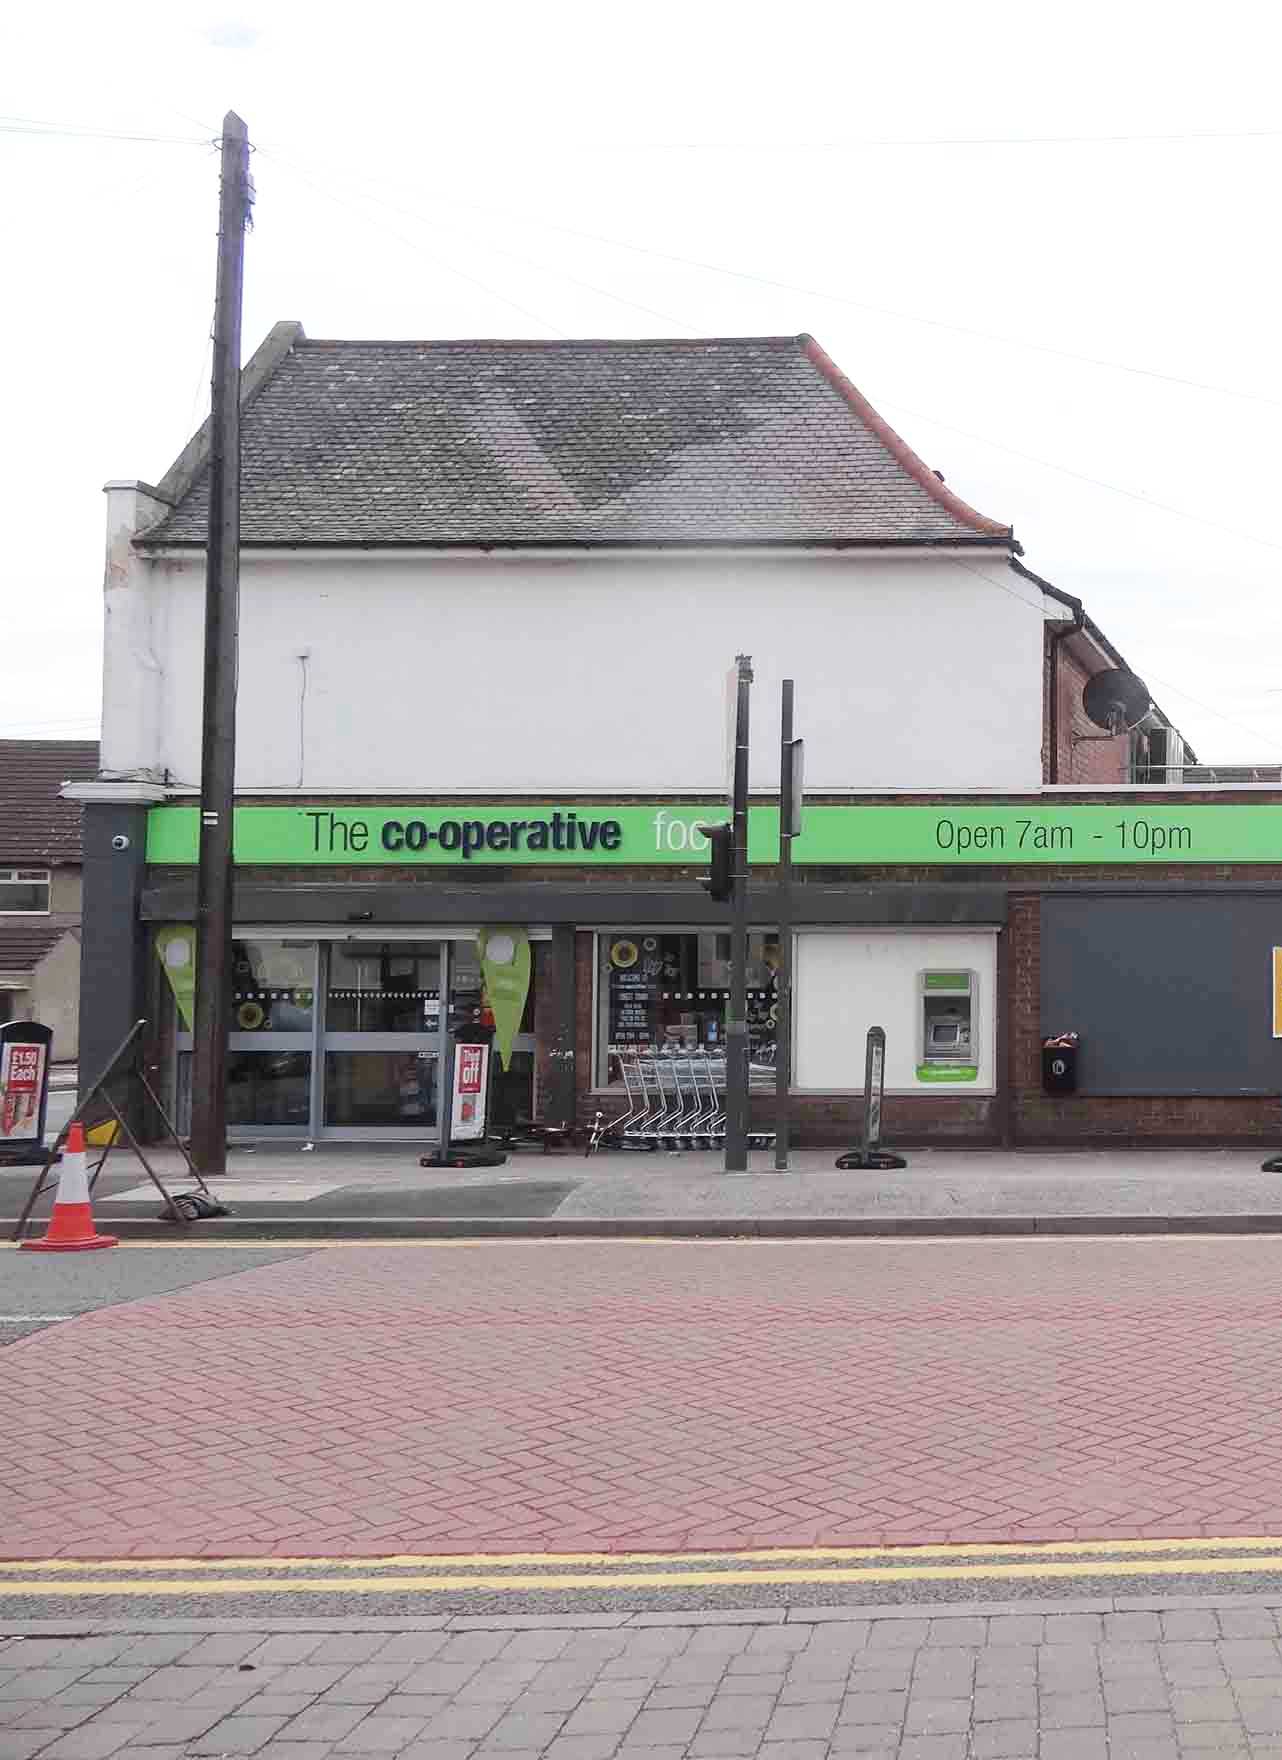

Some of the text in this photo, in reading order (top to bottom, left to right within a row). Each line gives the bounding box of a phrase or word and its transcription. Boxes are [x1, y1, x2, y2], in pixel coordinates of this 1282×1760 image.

[305, 810, 718, 858] The co-operative foo
[936, 819, 1005, 855] Open
[1015, 819, 1073, 849] 7am
[1116, 819, 1192, 855] 10pm
[11, 1050, 37, 1065] £1.50
[11, 1065, 36, 1081] Each
[463, 1062, 480, 1084] off
